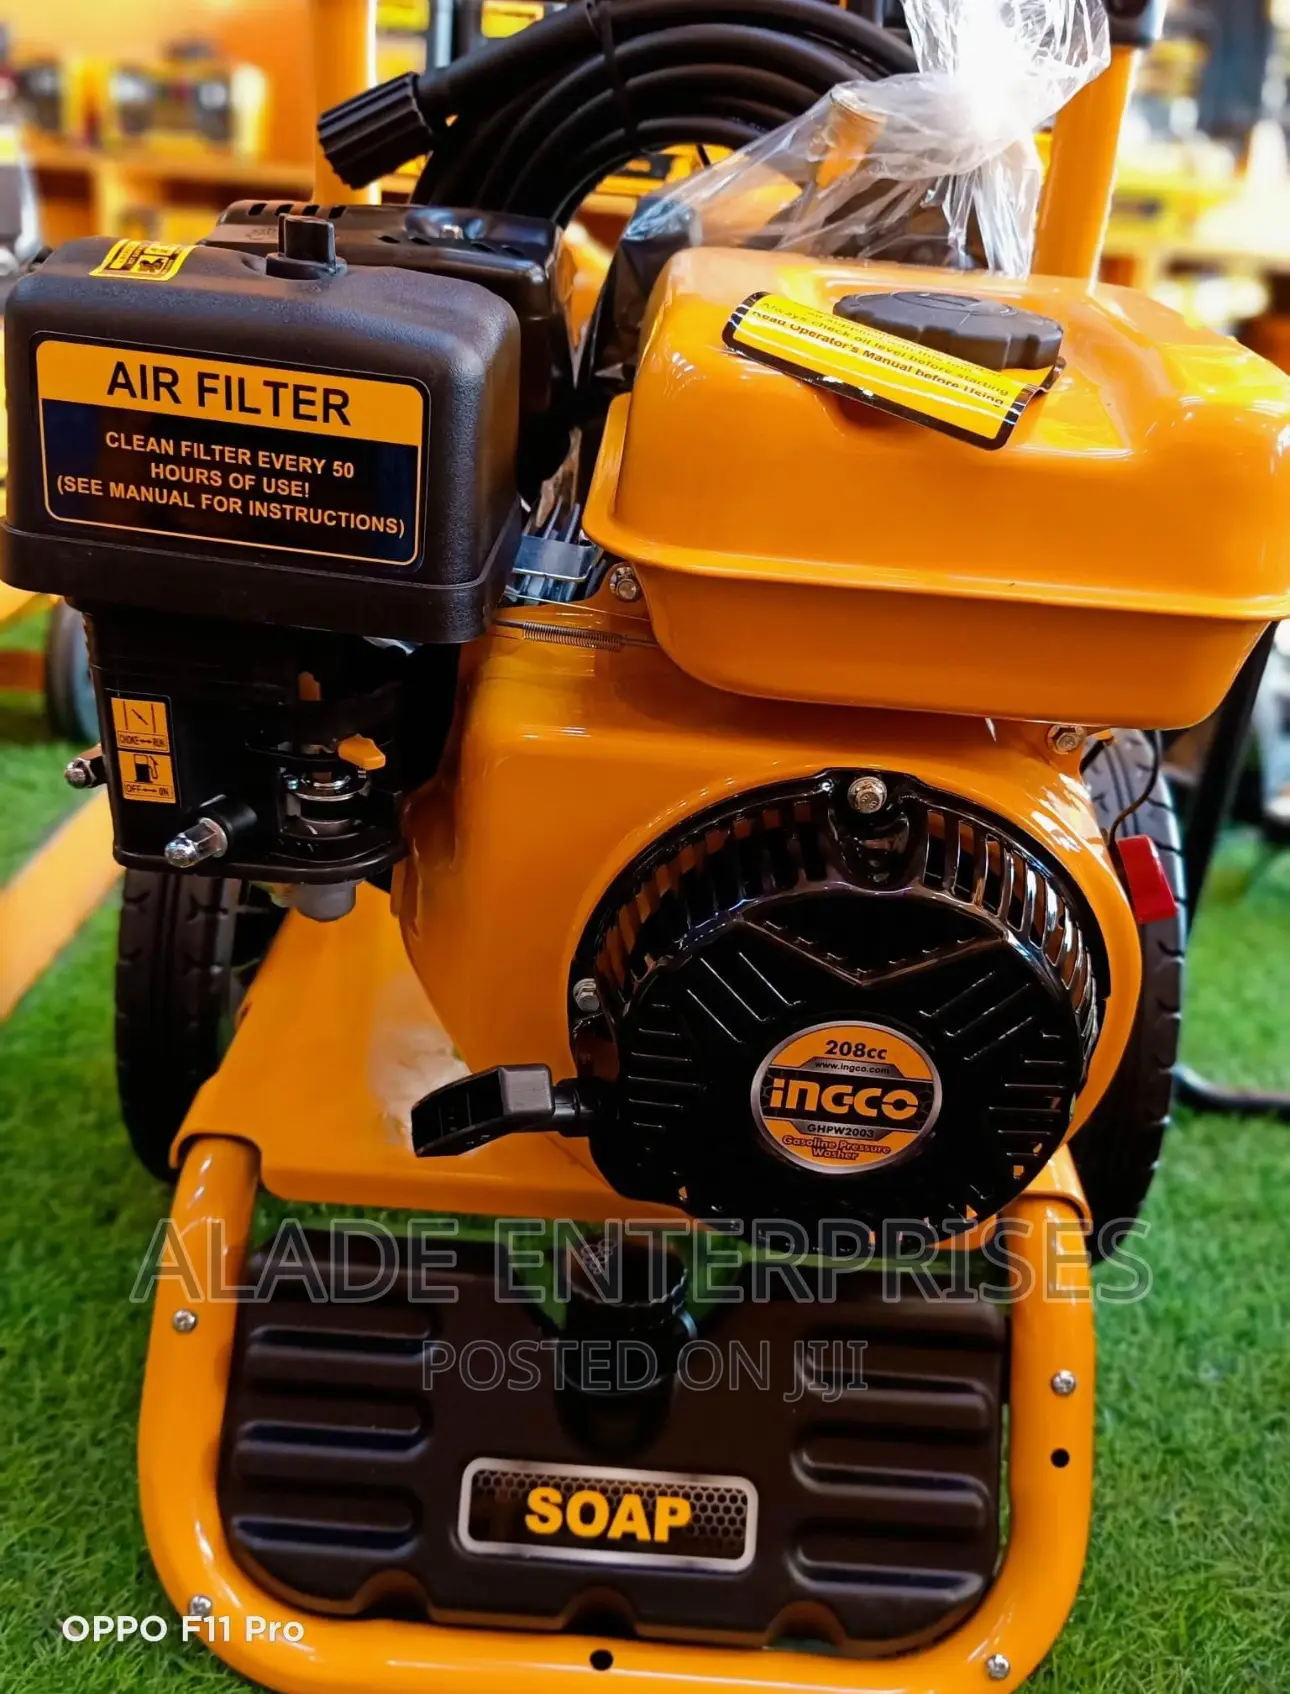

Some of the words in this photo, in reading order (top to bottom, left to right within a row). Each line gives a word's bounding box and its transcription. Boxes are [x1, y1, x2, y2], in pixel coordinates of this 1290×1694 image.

[752, 310, 786, 327] Read
[789, 324, 860, 354] Operator's
[862, 349, 912, 373] Manual
[914, 368, 960, 389] before
[811, 320, 851, 339] check
[854, 335, 872, 346] oil
[874, 342, 905, 357] level
[909, 353, 953, 375] before
[955, 371, 1009, 397] starting
[107, 361, 181, 405] AIR
[197, 371, 351, 427] FILTER
[105, 431, 174, 456] CLEAN
[181, 441, 252, 466] FILTER
[258, 451, 327, 475] EVERY
[332, 461, 355, 479] 50
[150, 462, 223, 488] HOURS
[228, 472, 256, 491] OF
[263, 476, 310, 499] USE!
[57, 474, 104, 496] (SEE
[109, 481, 196, 509] MANUAL
[200, 493, 243, 515] FOR
[249, 500, 405, 539] INSTRUCTIONS)
[126, 784, 142, 793] OFF
[159, 787, 169, 796] ON
[815, 1060, 890, 1076] www.ingco.com
[825, 1040, 888, 1061] 208cc
[782, 1134, 839, 1151] Gasoline
[839, 1139, 892, 1155] Pressure
[807, 1123, 875, 1139] GHPW2003
[812, 1147, 860, 1161] Washer
[525, 1486, 693, 1543] SOAP
